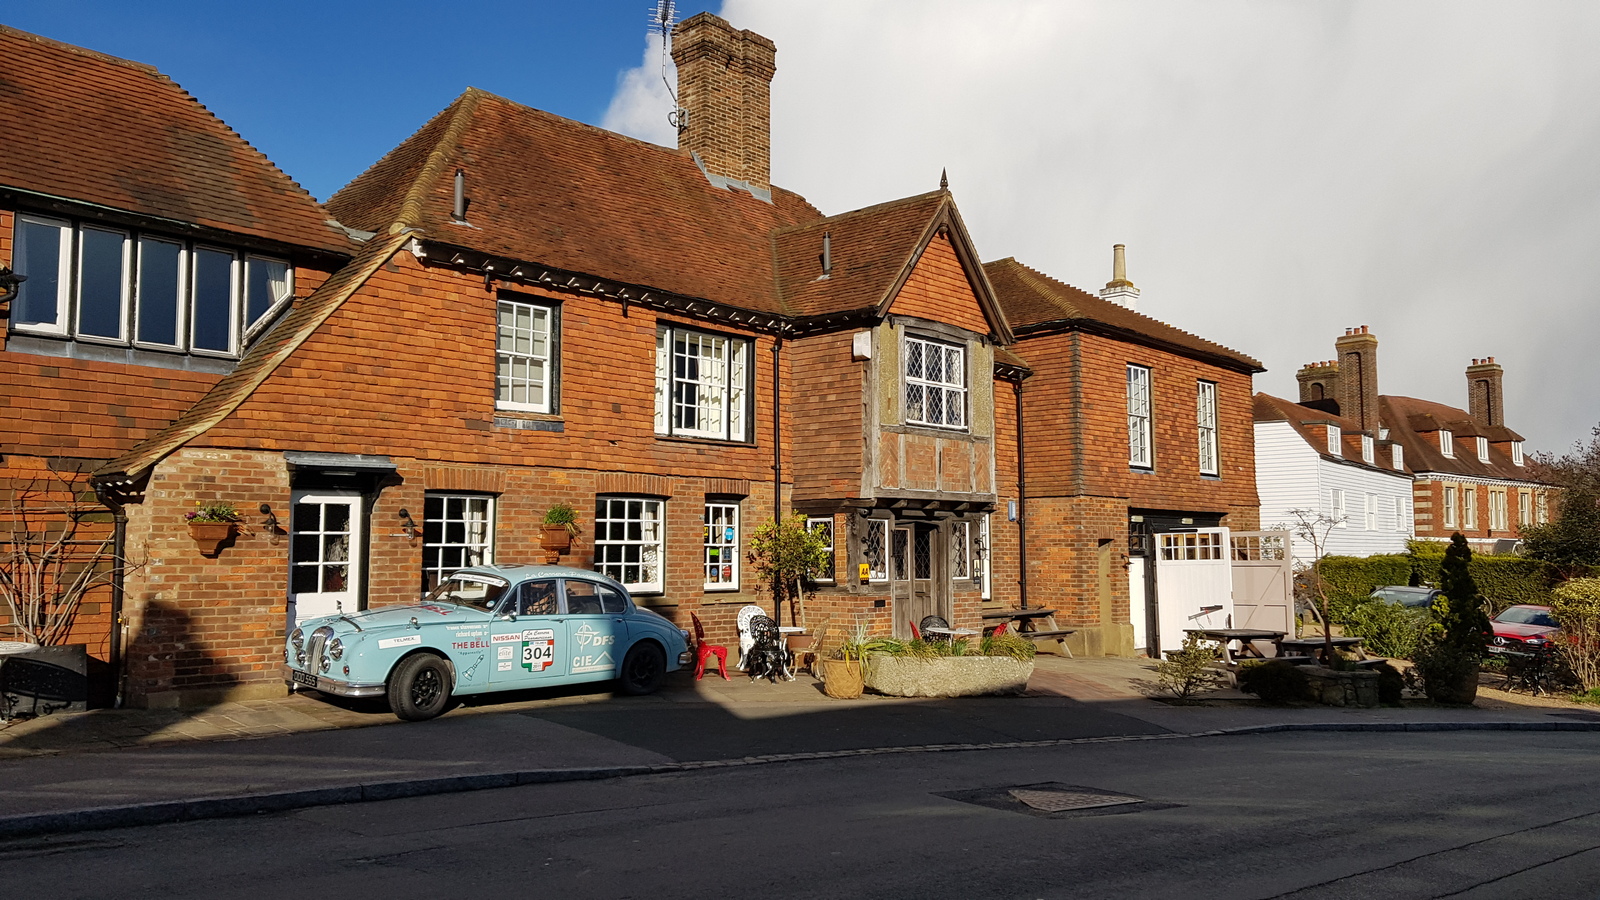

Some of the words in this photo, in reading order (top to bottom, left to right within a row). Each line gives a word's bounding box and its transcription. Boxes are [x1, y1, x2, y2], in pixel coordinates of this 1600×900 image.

[452, 641, 468, 649] THE
[593, 635, 615, 646] DFS
[523, 646, 552, 661] 304
[573, 655, 592, 667] CIE
[305, 675, 316, 686] 555
